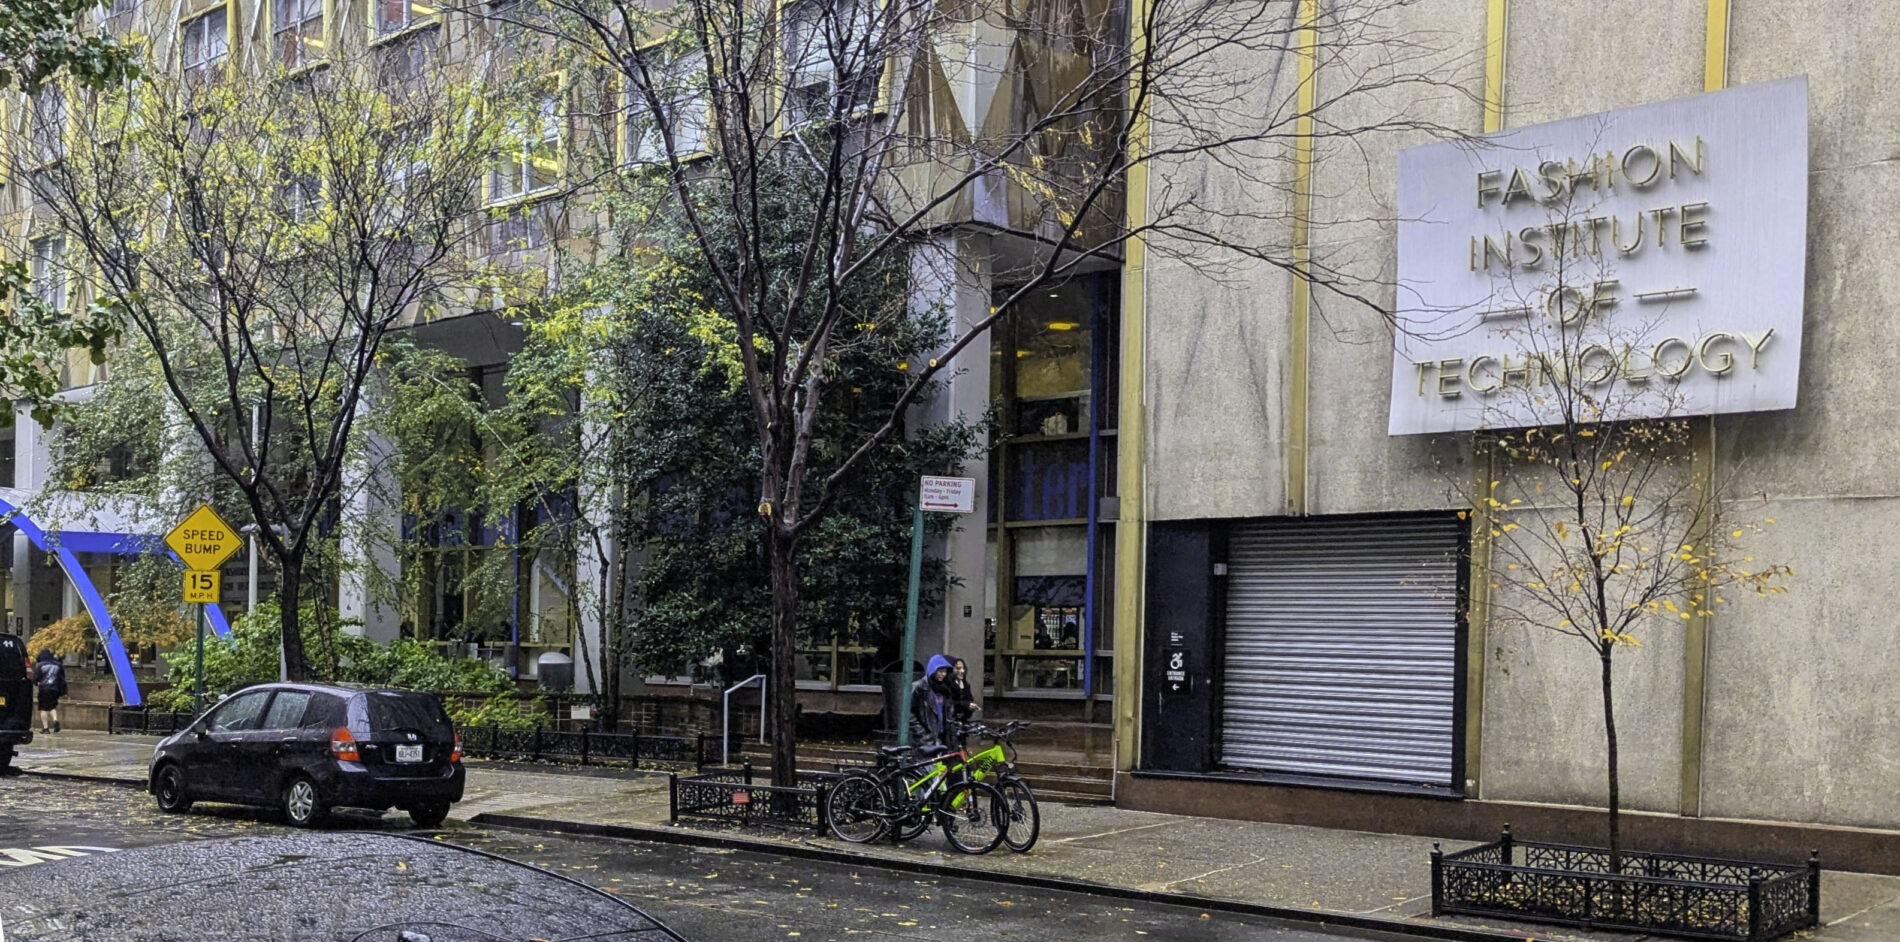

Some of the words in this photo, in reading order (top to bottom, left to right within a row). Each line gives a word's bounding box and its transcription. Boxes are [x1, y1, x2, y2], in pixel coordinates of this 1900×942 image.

[1477, 135, 1706, 208] FASHION
[1469, 201, 1710, 272] INSTITUTE
[1546, 279, 1620, 328] OF
[1413, 327, 1774, 397] TECHNOLOGY
[935, 480, 962, 488] PARKING
[183, 529, 224, 541] SPEED
[185, 543, 221, 555] BUMP
[191, 574, 213, 590] 15
